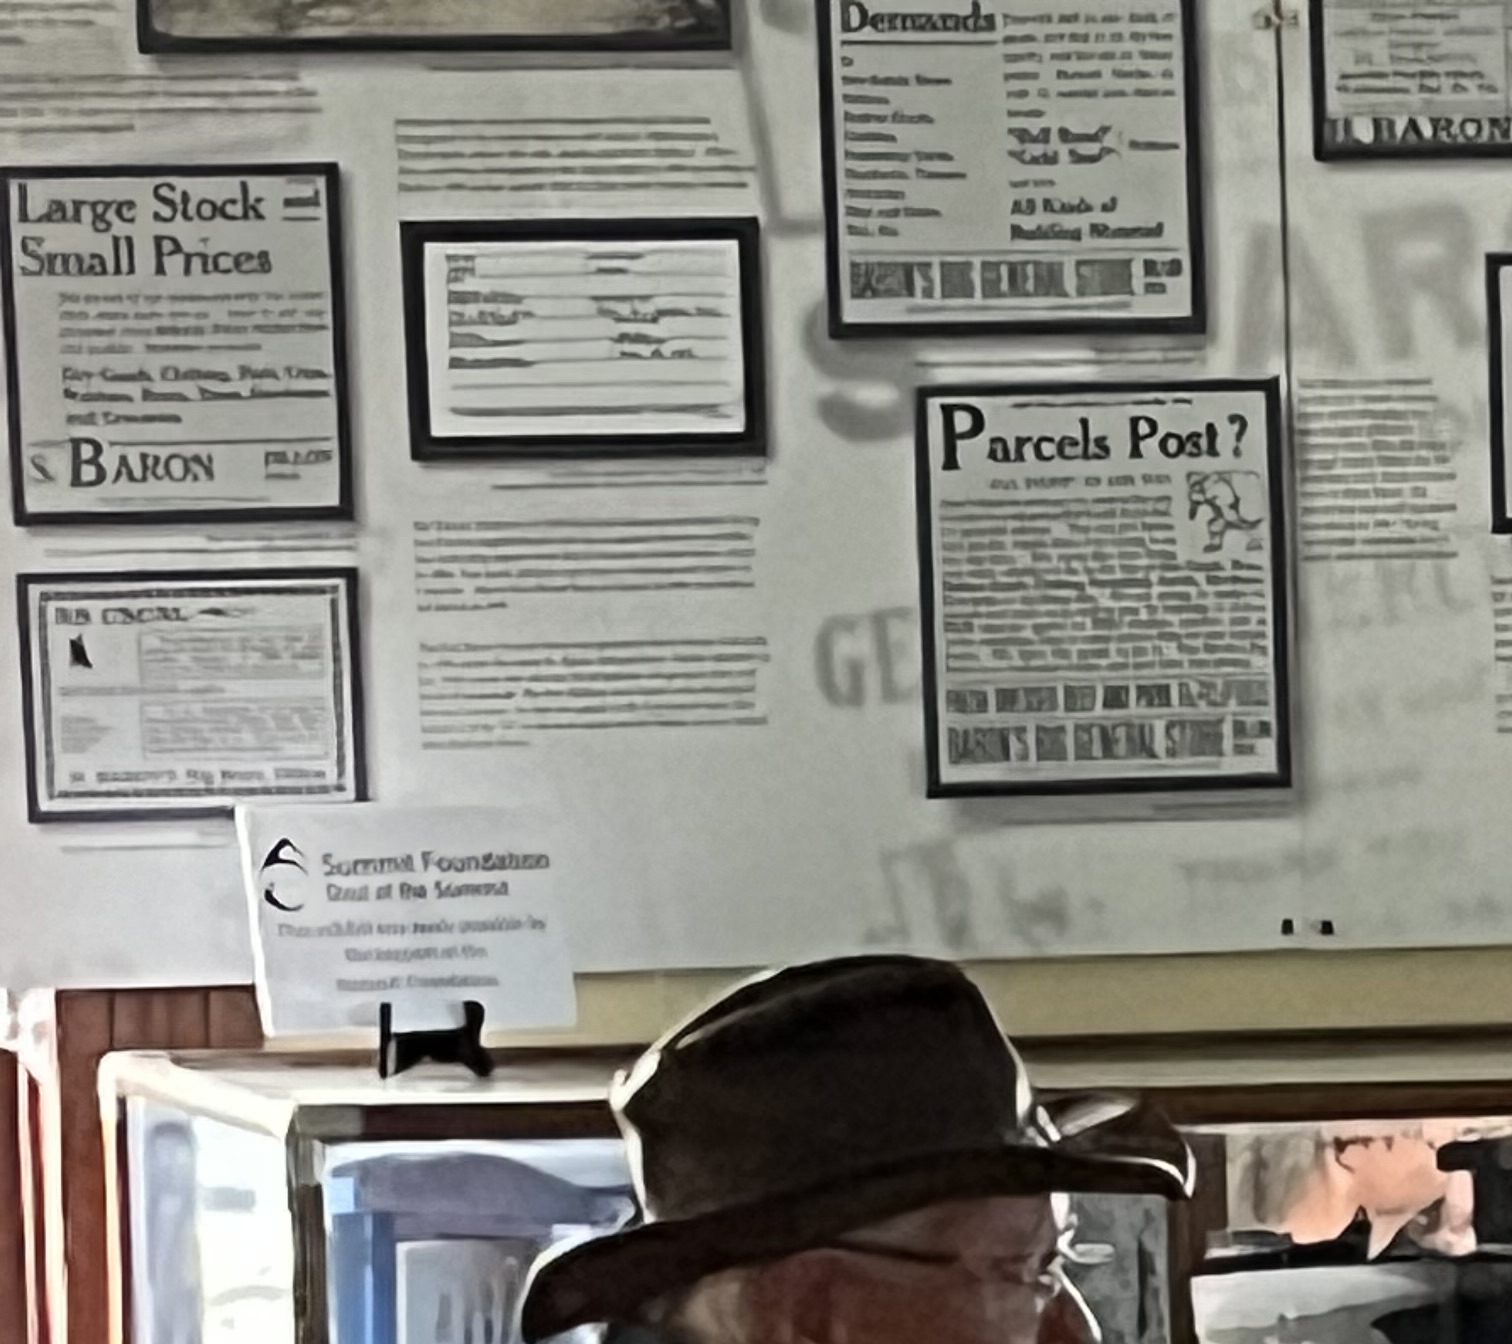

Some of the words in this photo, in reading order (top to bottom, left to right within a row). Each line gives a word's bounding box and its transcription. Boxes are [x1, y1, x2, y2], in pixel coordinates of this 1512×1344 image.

[840, 0, 996, 32] Demands
[17, 183, 138, 232] Large
[152, 180, 266, 222] Stock
[18, 235, 136, 276] Small
[153, 234, 273, 276] Prices
[69, 436, 216, 488] BARON
[939, 402, 1111, 471] Parcels
